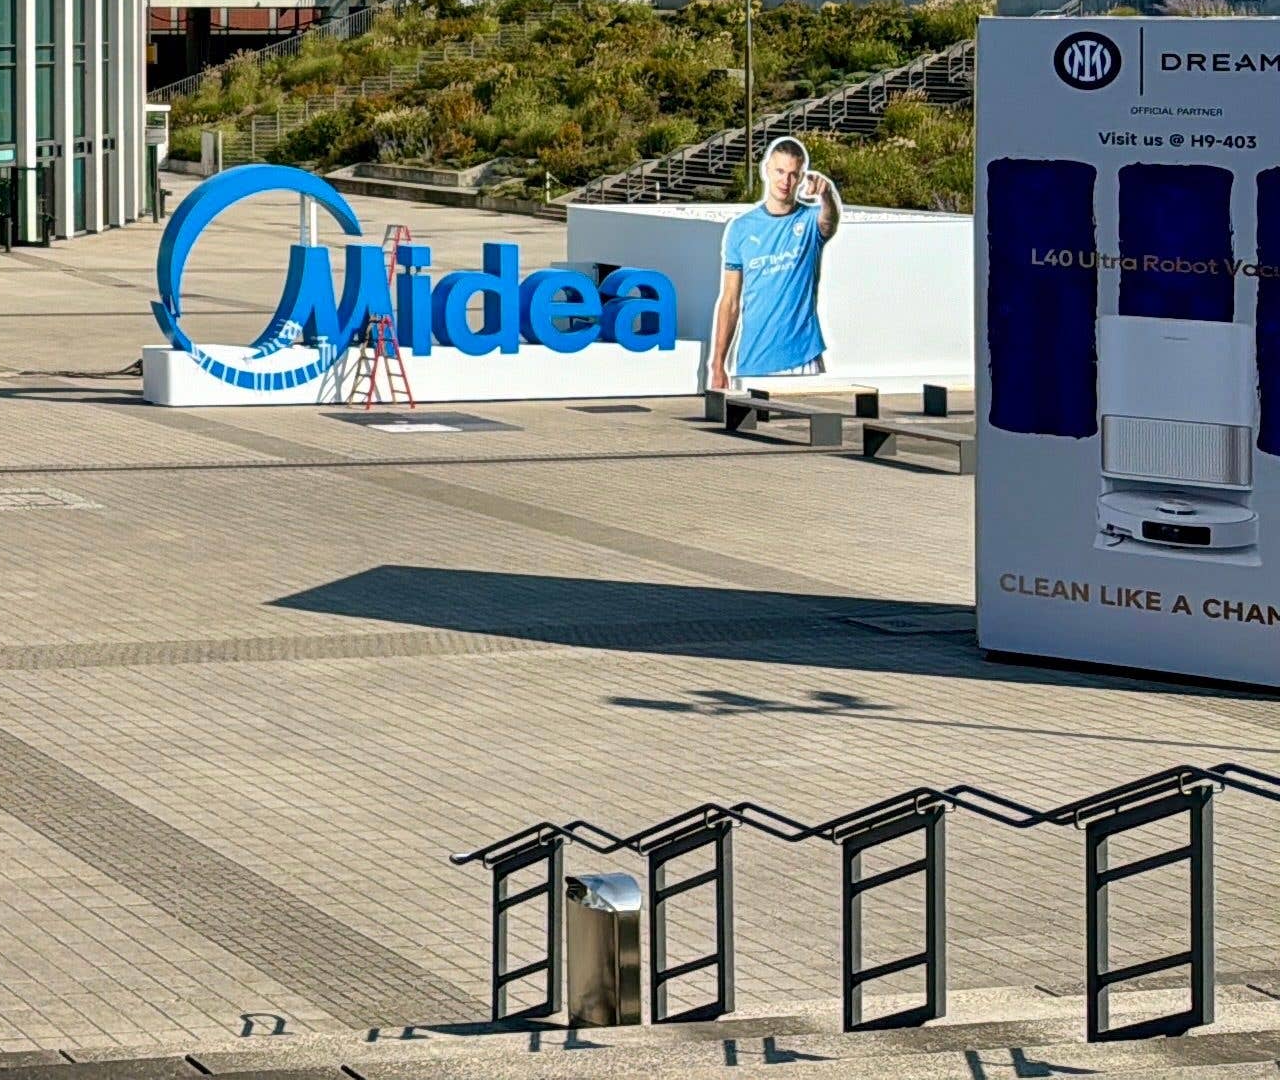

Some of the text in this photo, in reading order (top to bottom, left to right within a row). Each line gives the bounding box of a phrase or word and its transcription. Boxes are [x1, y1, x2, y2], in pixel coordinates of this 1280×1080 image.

[1161, 53, 1280, 72] DREAM
[1130, 106, 1223, 117] OFFICIAL PARTNER
[1098, 131, 1257, 149] Visit us @ H9-403
[1031, 248, 1073, 267] L40
[1078, 250, 1138, 271] Ultra
[1143, 254, 1218, 275] Robot
[246, 240, 677, 358] Midea
[1000, 573, 1089, 602] CLEAN
[1100, 585, 1161, 611] LIKE
[1172, 595, 1192, 615] A
